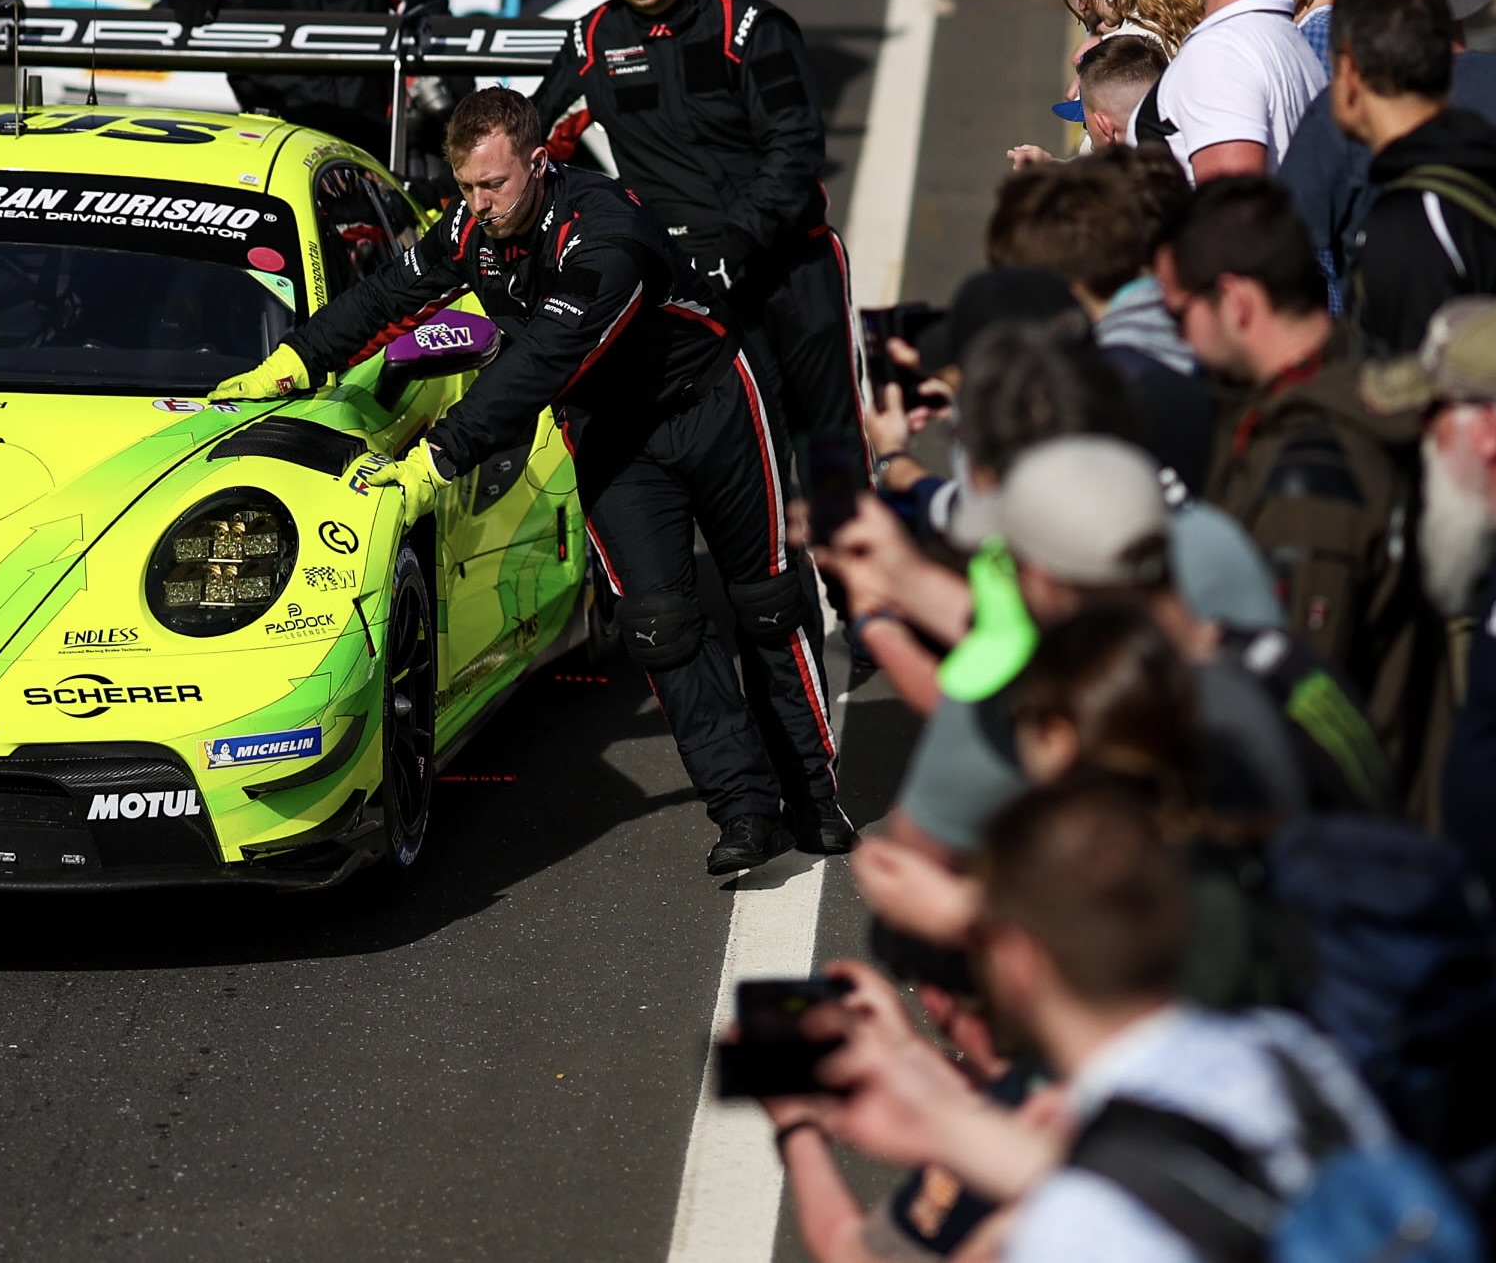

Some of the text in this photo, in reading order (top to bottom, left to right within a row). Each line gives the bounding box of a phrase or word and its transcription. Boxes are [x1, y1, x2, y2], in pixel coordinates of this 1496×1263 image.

[734, 6, 758, 46] HRX
[573, 20, 587, 58] HRX
[72, 190, 261, 230] TURISMO
[45, 211, 127, 226] DRIVING
[130, 217, 247, 241] SIMULATOR
[548, 298, 584, 317] MANTHEY
[426, 327, 473, 350] KW
[264, 613, 336, 635] PADDOCK
[284, 627, 326, 640] LEGENDS
[64, 627, 139, 645] ENDLESS
[23, 684, 203, 706] SCHERER
[235, 737, 315, 759] MICHELIN
[87, 789, 200, 820] MOTUL
